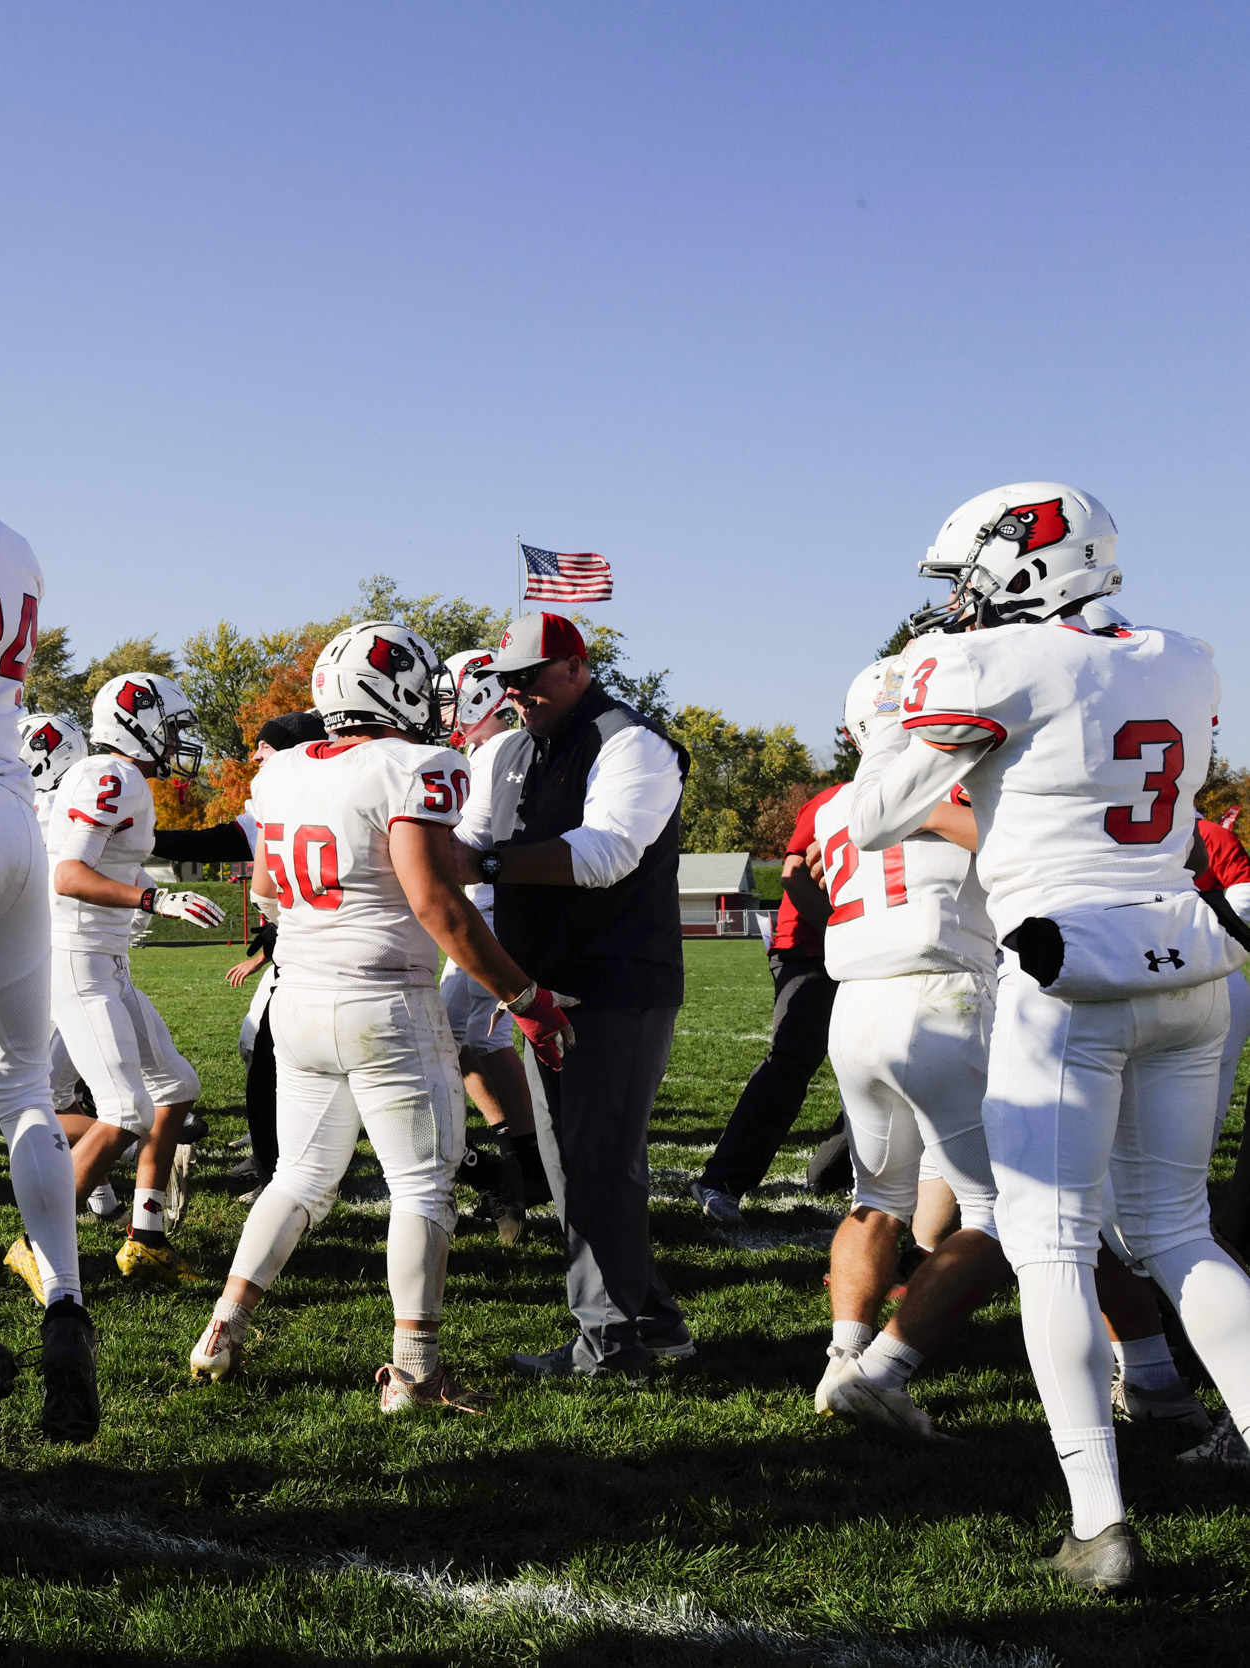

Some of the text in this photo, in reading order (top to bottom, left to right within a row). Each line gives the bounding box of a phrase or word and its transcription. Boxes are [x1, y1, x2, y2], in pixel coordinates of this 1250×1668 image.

[903, 657, 938, 713] 3
[96, 775, 123, 814] 2
[421, 769, 471, 814] 50
[1103, 719, 1185, 845] 3
[263, 822, 345, 912] 50
